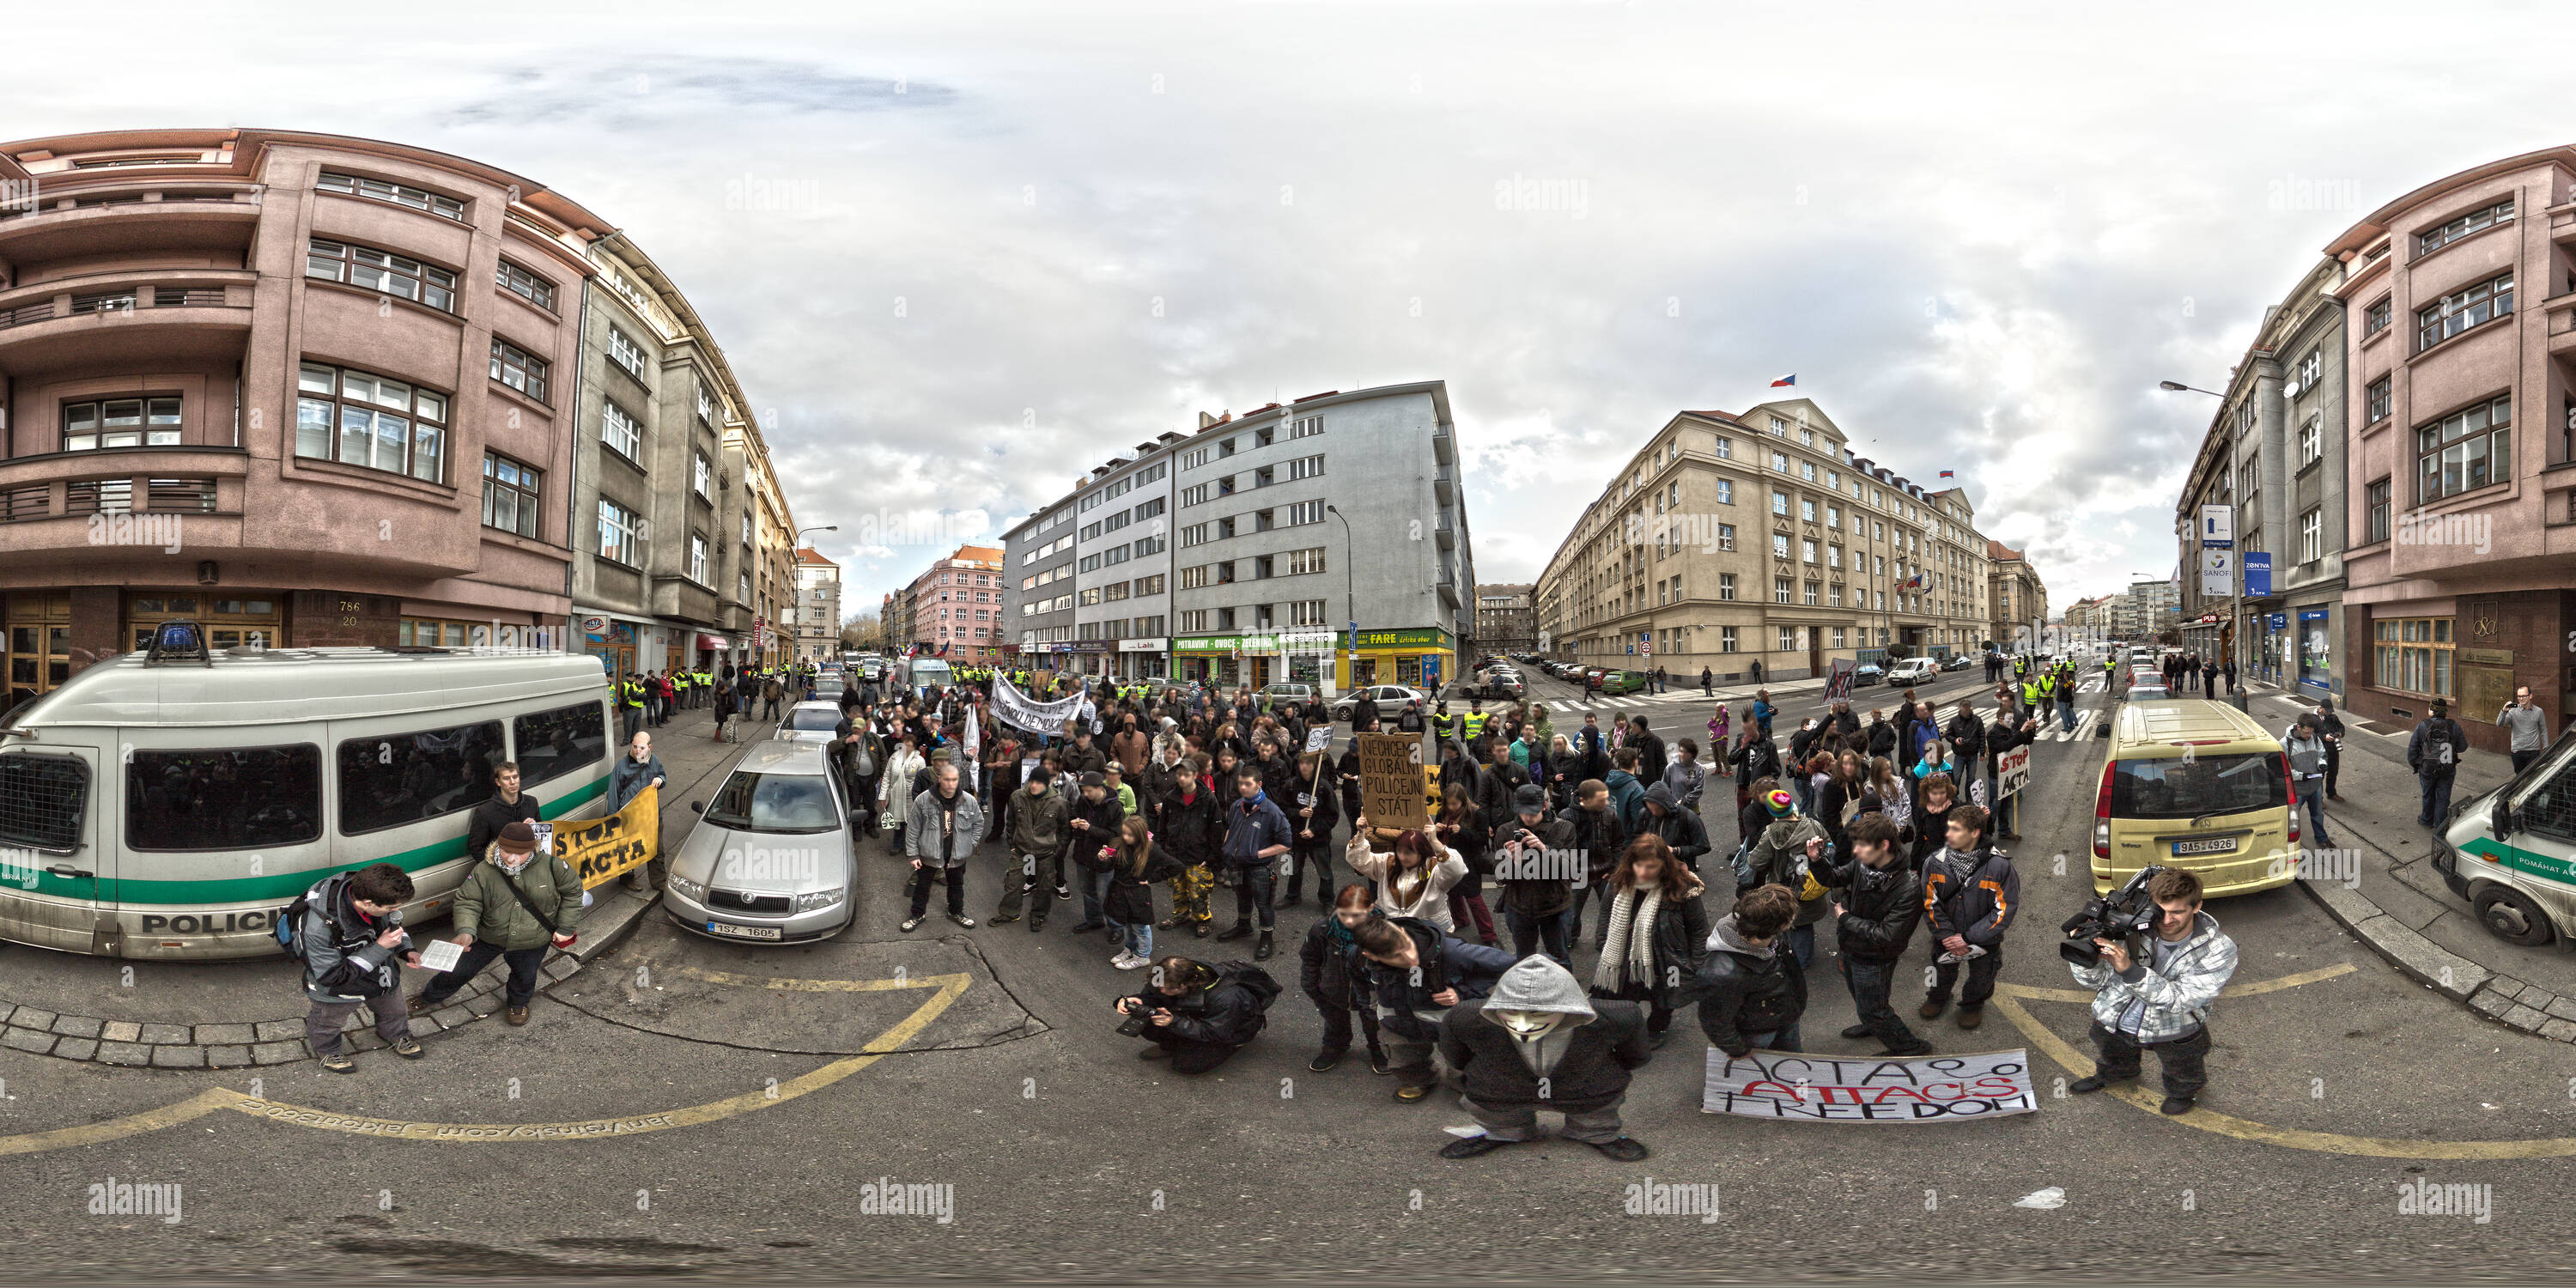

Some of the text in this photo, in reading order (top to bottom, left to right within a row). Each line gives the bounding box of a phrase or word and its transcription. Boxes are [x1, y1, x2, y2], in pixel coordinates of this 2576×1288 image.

[340, 601, 360, 611] 786
[343, 617, 356, 626] 20
[1177, 640, 1209, 649] POTRAVINY
[1214, 639, 1236, 648] OVOCE
[1241, 638, 1273, 648] ZELENINA
[1294, 635, 1329, 644] SELEKTO
[1370, 634, 1397, 644] FARE
[1362, 738, 1419, 758] NECHCEM
[2000, 749, 2029, 773] STOP
[2002, 769, 2029, 795] ACTA
[1377, 793, 1411, 817] STÁT
[555, 816, 622, 856] STOP
[2181, 839, 2232, 853] 9A5 4926
[579, 839, 647, 879] ACTA
[2519, 857, 2560, 874] POMÁHAT
[717, 925, 775, 938] 1SZ 1605
[1724, 1055, 1918, 1086] ACTA
